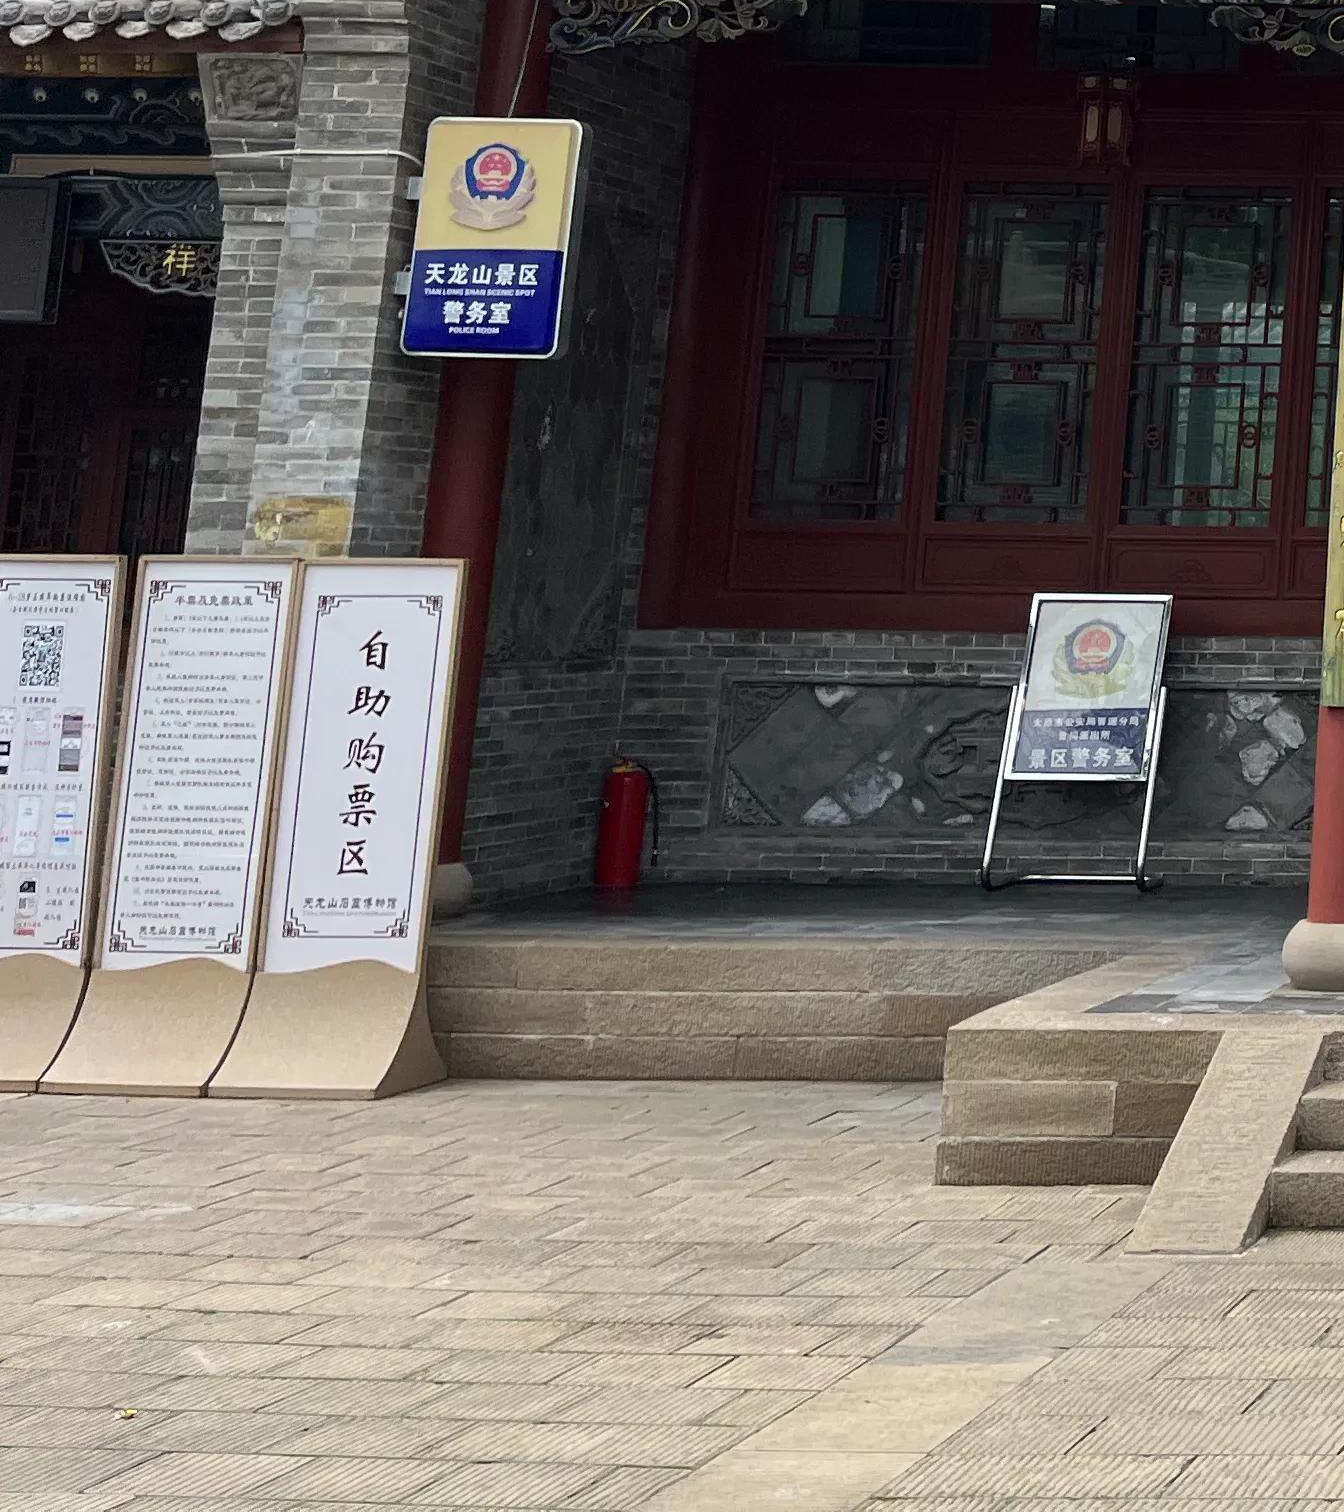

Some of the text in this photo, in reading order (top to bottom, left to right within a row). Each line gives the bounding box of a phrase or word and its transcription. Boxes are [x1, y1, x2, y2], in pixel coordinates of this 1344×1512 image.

[424, 262, 539, 285] 天龙山景区
[424, 288, 441, 296] TIAN
[443, 300, 512, 324] 警务室
[448, 327, 500, 335] POLICE ROOM
[336, 629, 392, 876] 自助购票区
[1029, 747, 1134, 768] 景区警务室
